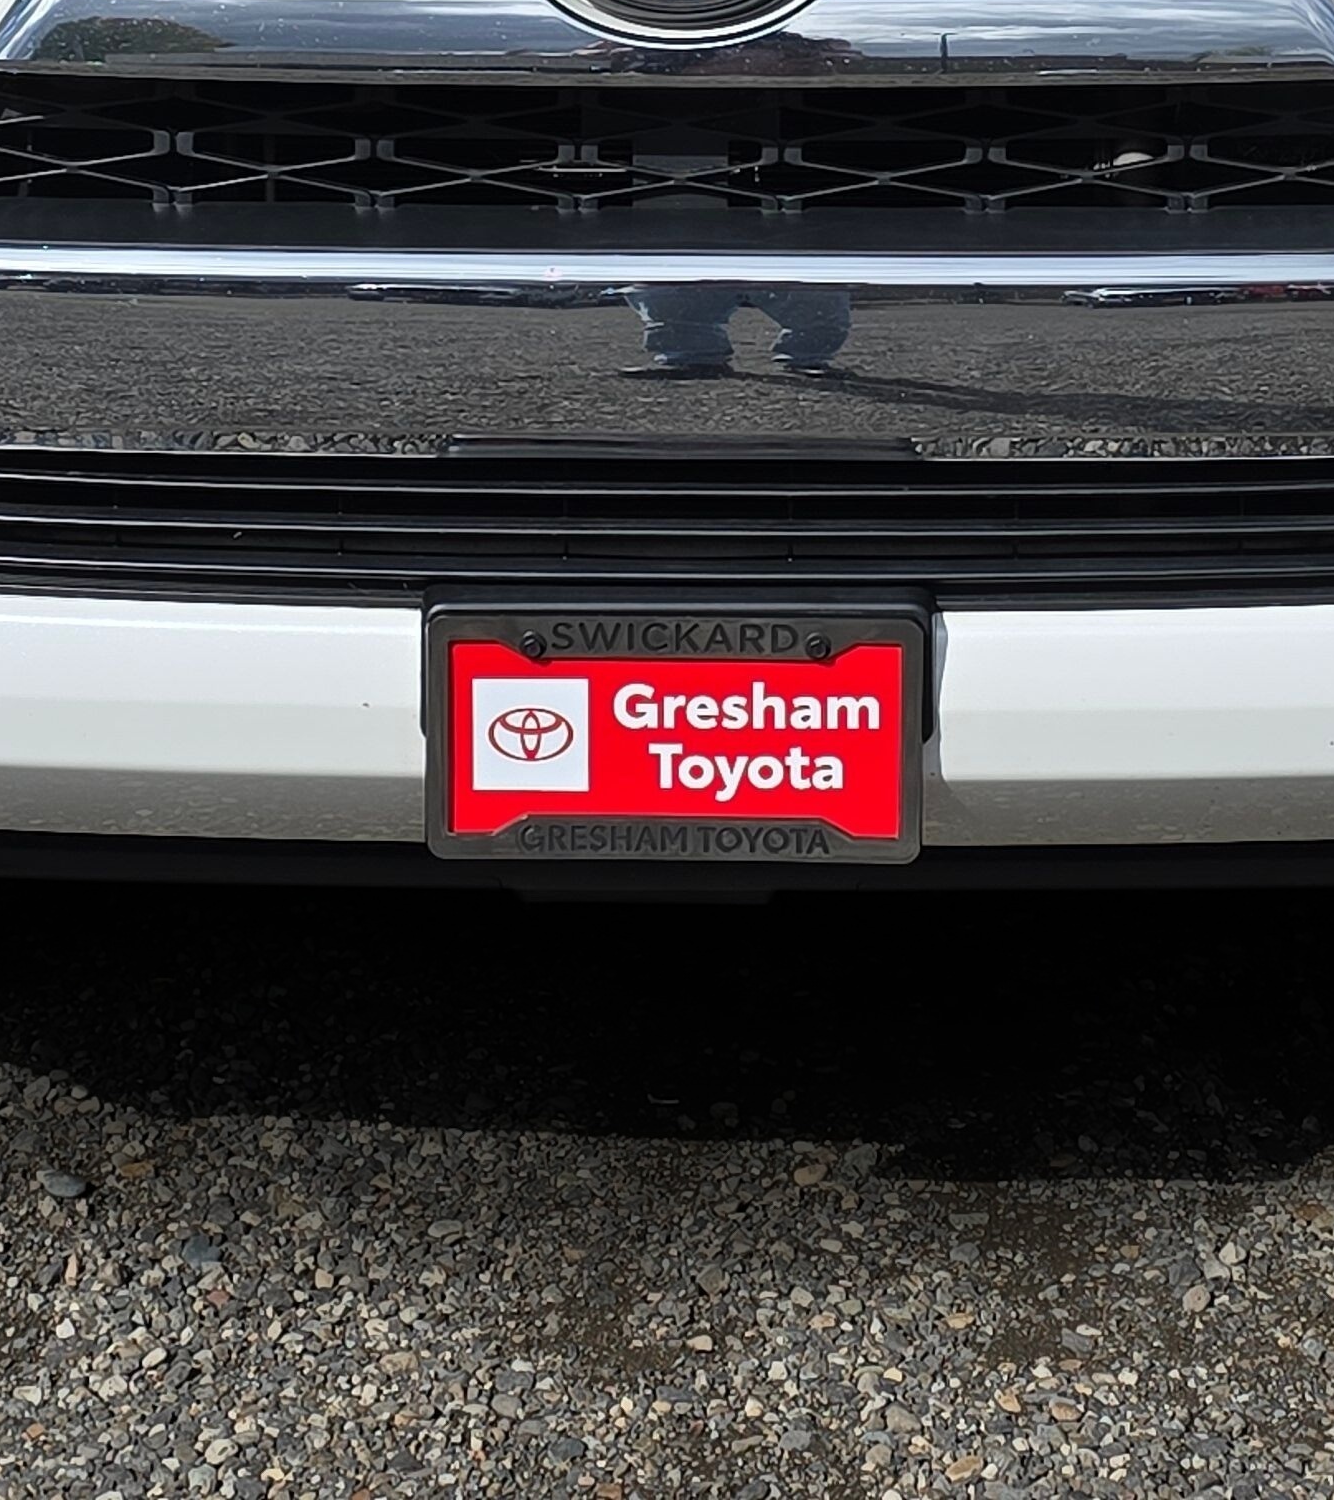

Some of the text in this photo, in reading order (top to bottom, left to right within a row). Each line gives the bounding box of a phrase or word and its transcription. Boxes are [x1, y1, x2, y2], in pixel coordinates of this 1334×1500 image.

[551, 621, 799, 654] SWICKARD
[614, 681, 881, 732] Gresham
[648, 743, 845, 802] Toyota
[518, 825, 831, 855] GRESHAM TOYOTA
